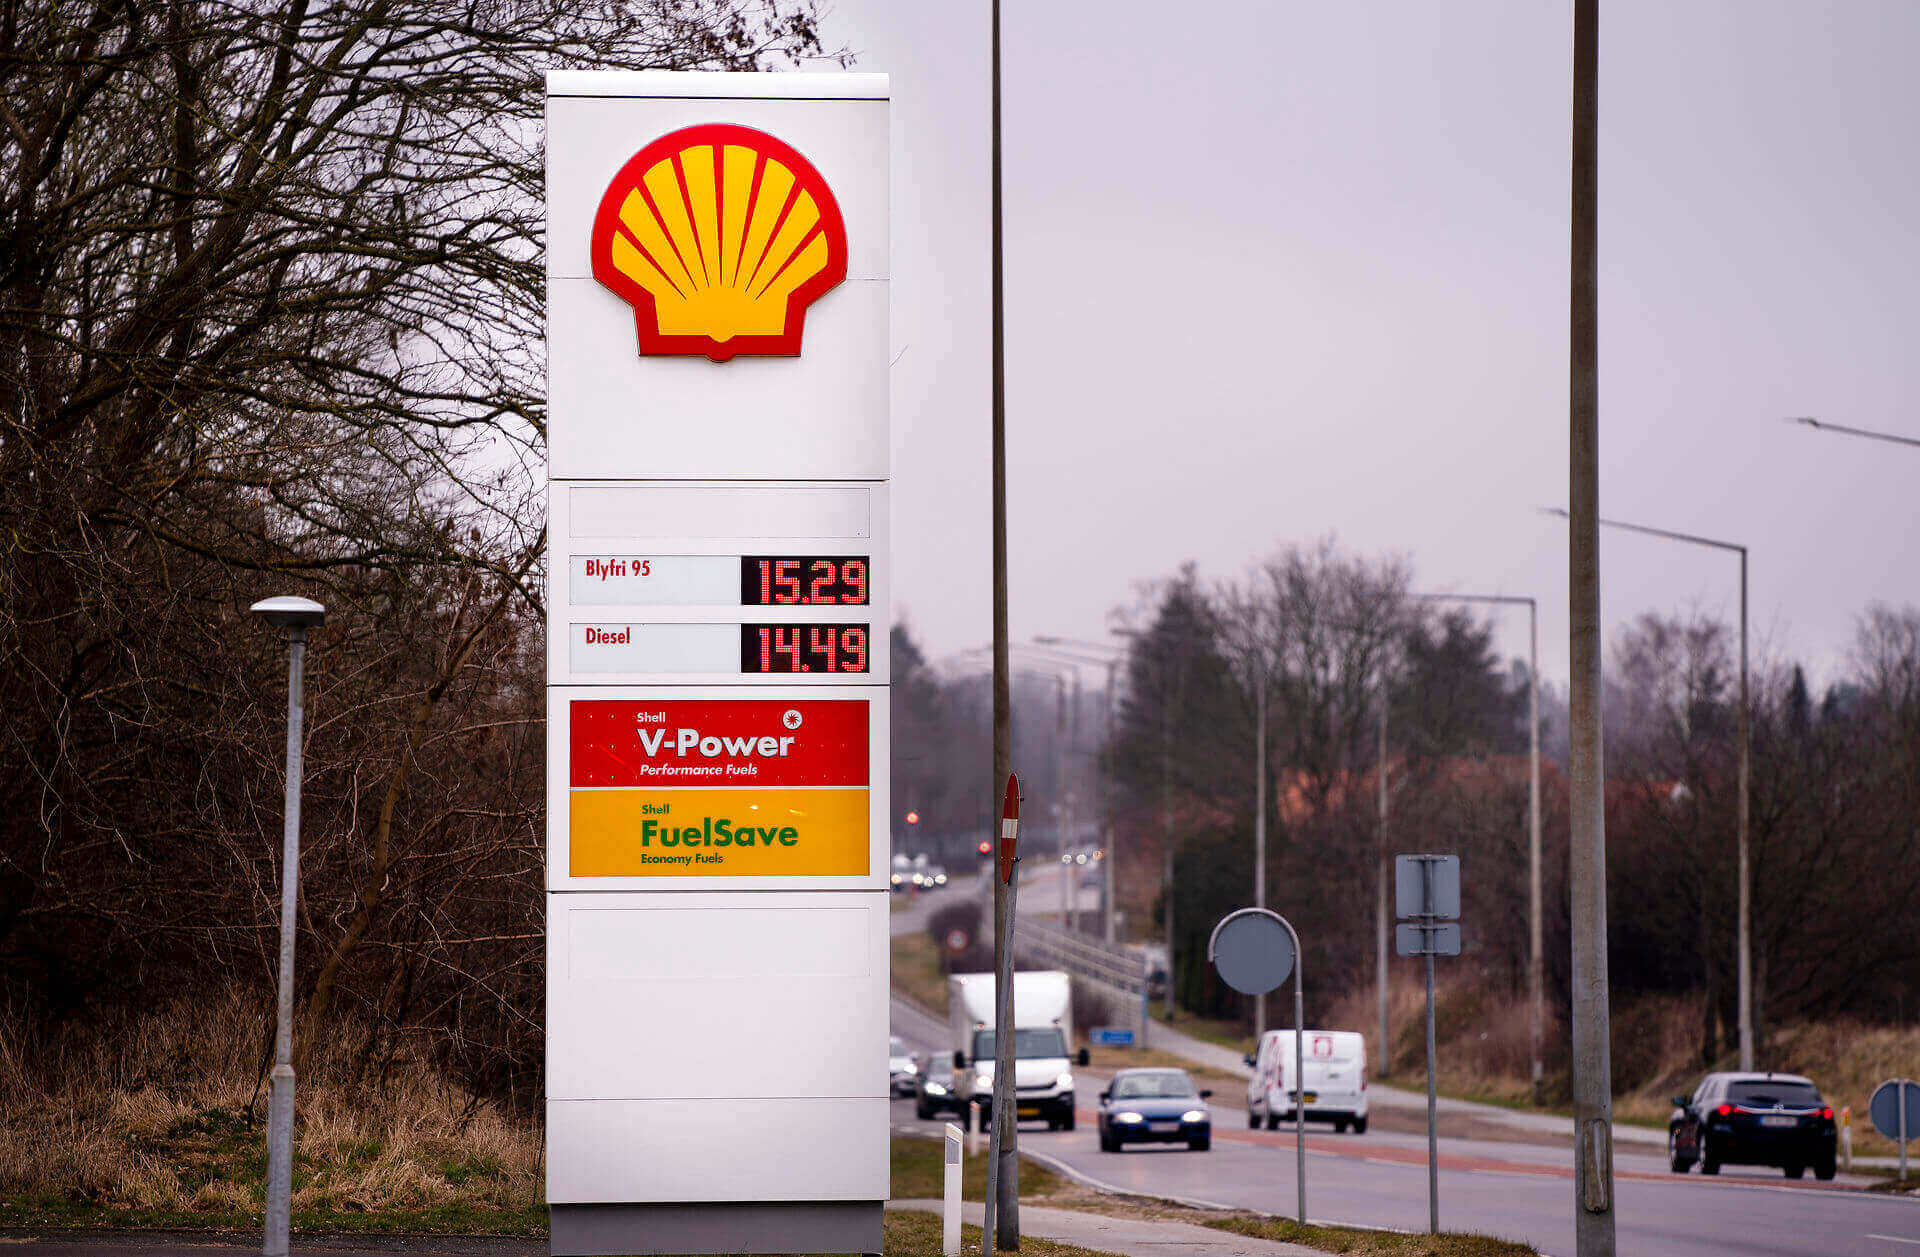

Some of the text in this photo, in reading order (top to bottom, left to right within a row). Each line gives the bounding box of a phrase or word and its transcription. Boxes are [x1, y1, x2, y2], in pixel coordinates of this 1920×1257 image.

[585, 559, 651, 581] Blyfri 95
[759, 560, 867, 604] 15.29
[585, 626, 631, 644] Diesel
[759, 628, 867, 672] 14.49
[637, 711, 666, 723] Shell
[636, 728, 796, 758] V-Power
[640, 763, 758, 776] Performance Fuels
[641, 804, 670, 815] Shell
[641, 817, 799, 847] FuelSave
[640, 852, 724, 866] Economy Fuels
